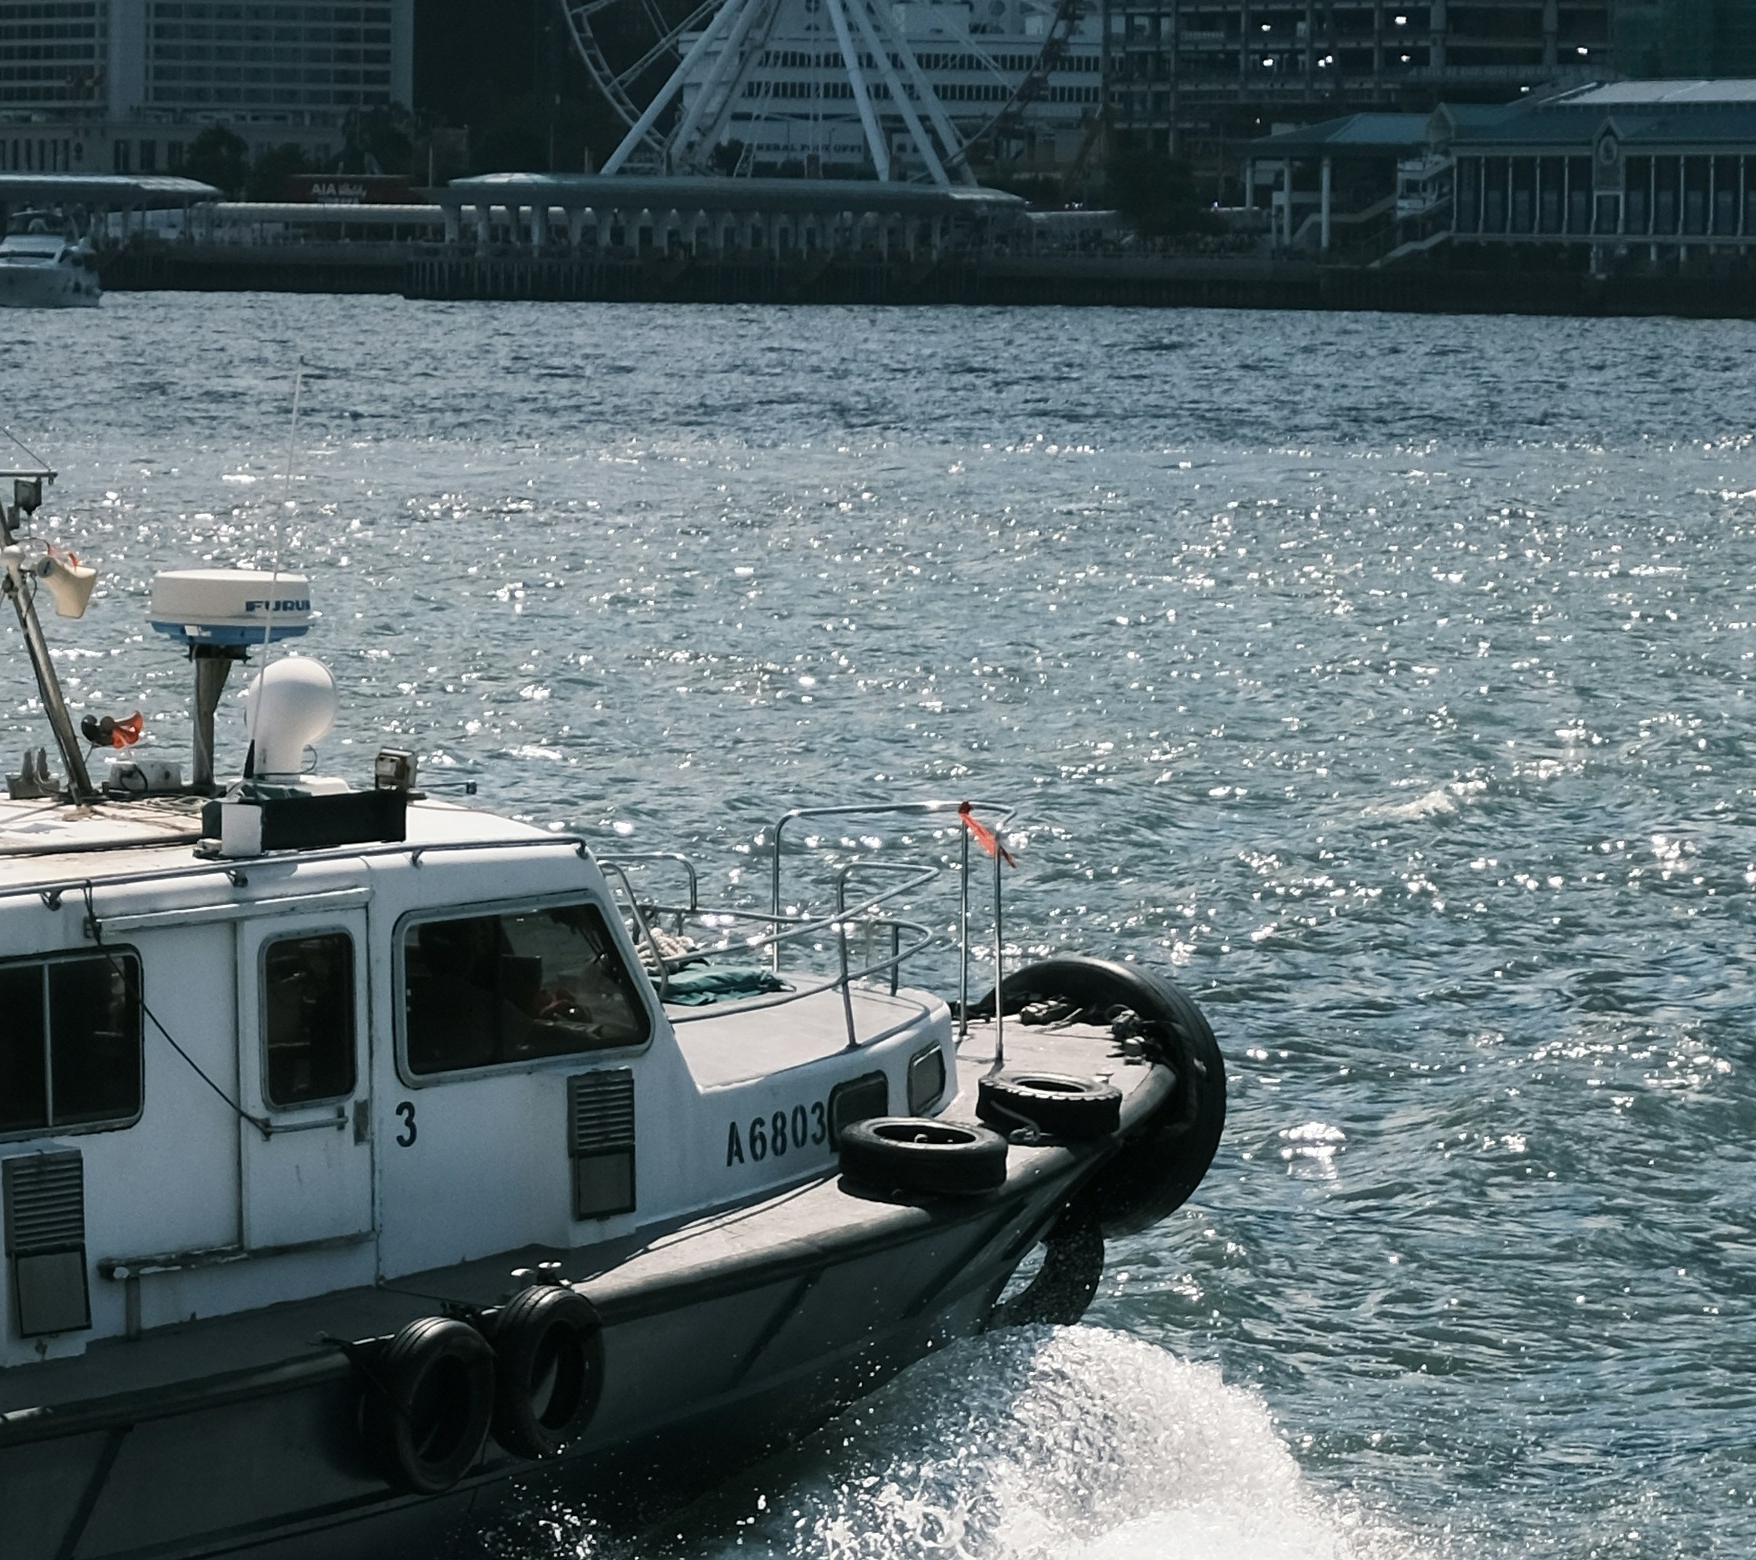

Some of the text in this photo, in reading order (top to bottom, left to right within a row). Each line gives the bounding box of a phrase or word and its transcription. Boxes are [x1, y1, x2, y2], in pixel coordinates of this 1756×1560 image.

[312, 183, 337, 195] AIA
[395, 1101, 418, 1148] 3
[726, 1101, 827, 1167] A6803
